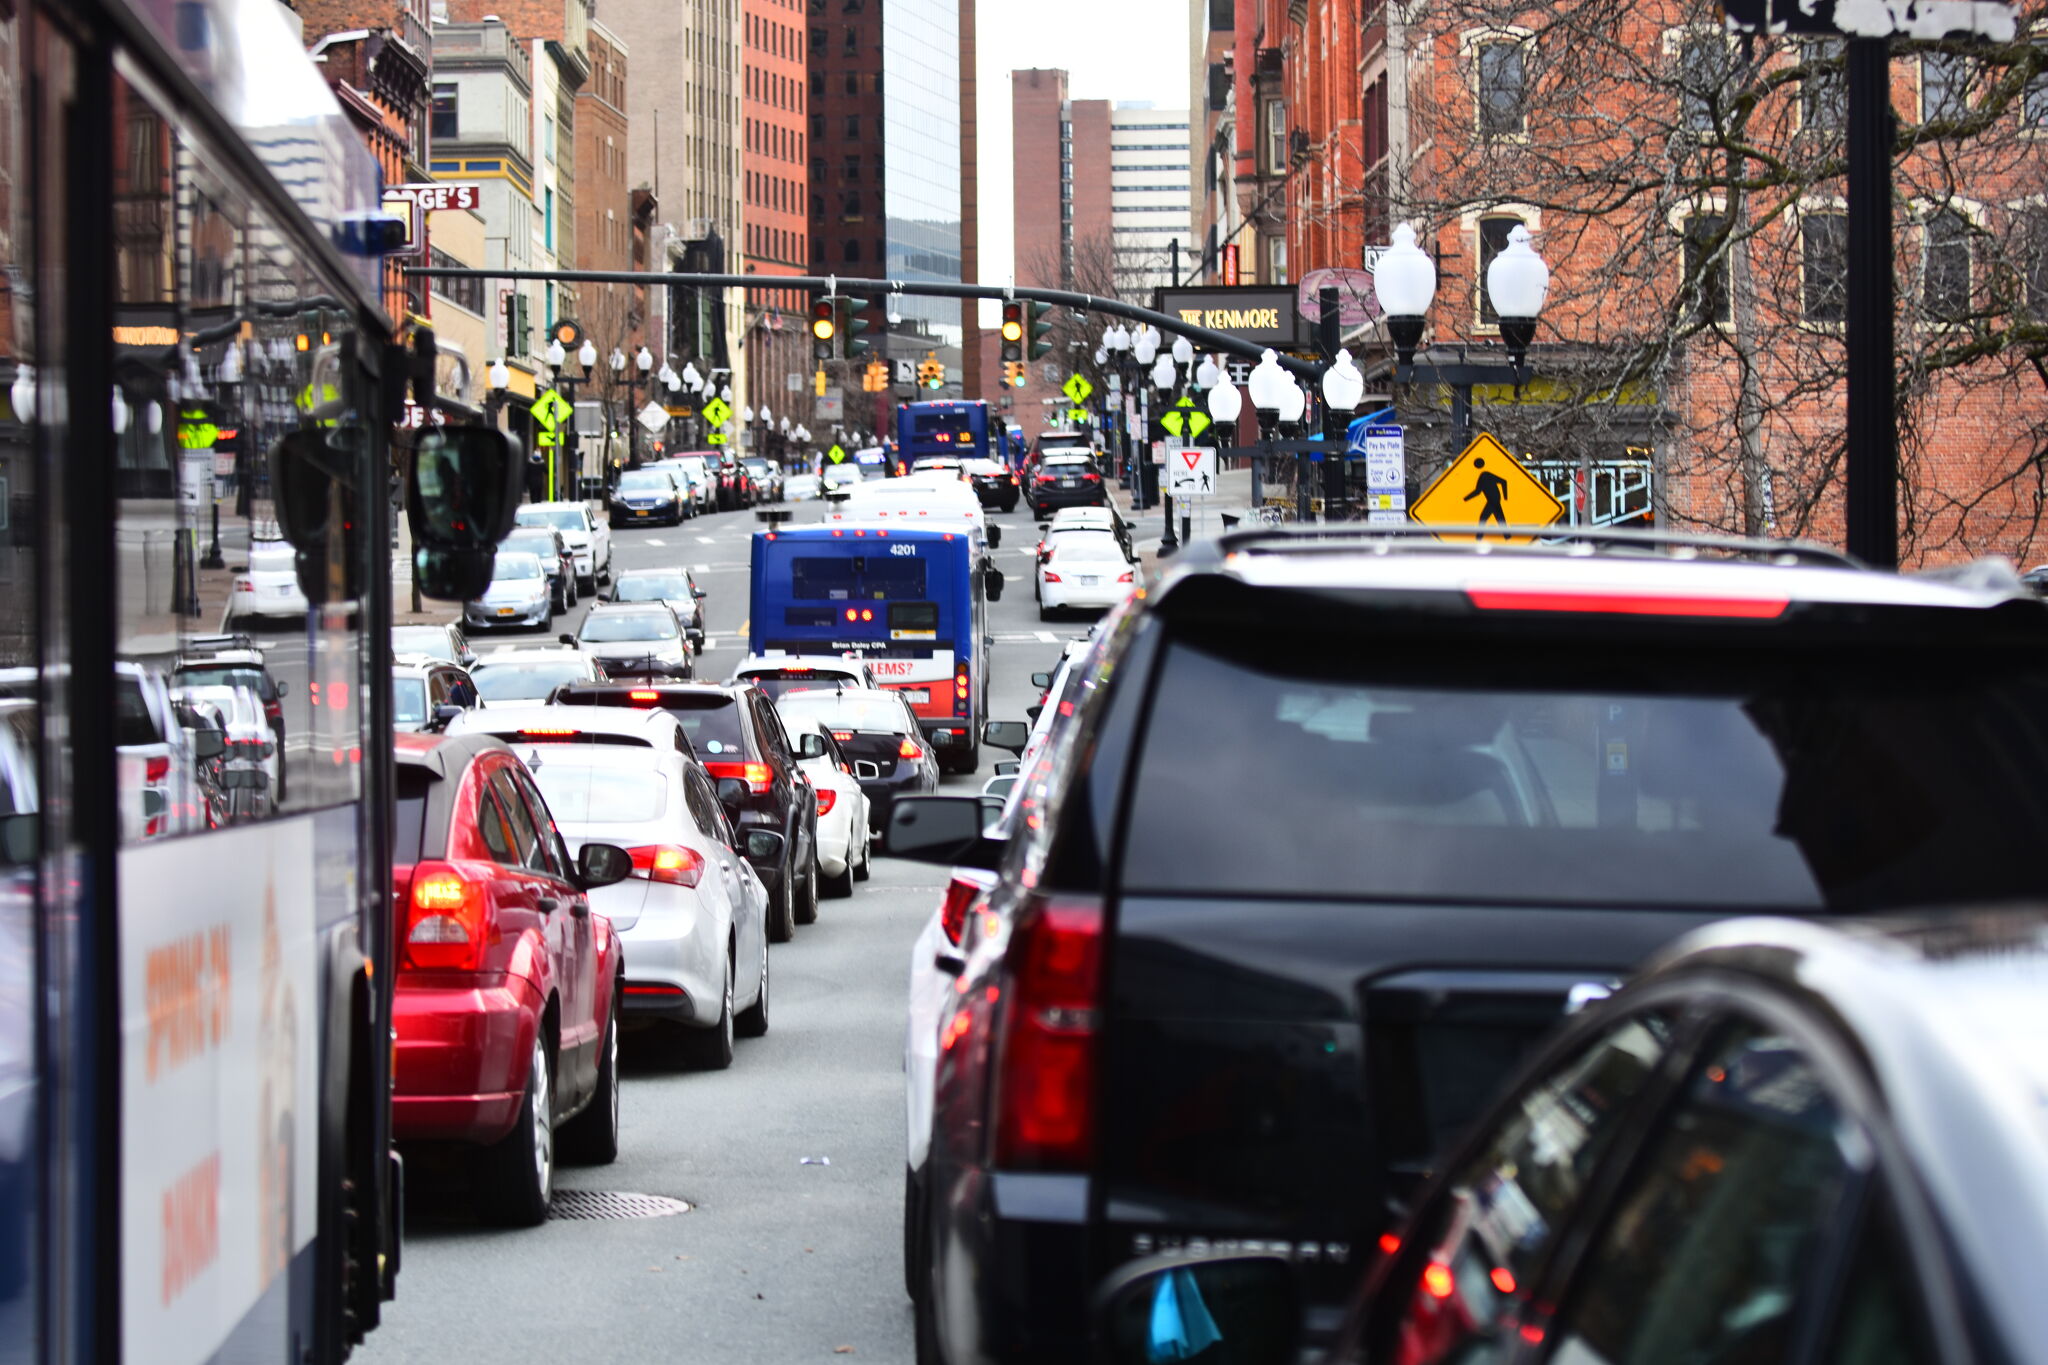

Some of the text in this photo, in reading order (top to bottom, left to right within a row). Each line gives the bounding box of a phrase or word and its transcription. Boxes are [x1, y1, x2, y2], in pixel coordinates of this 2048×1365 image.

[1205, 309, 1279, 329] KENMORE
[1543, 469, 1564, 481] THE
[890, 544, 916, 556] 4201
[866, 662, 914, 675] LEMS?
